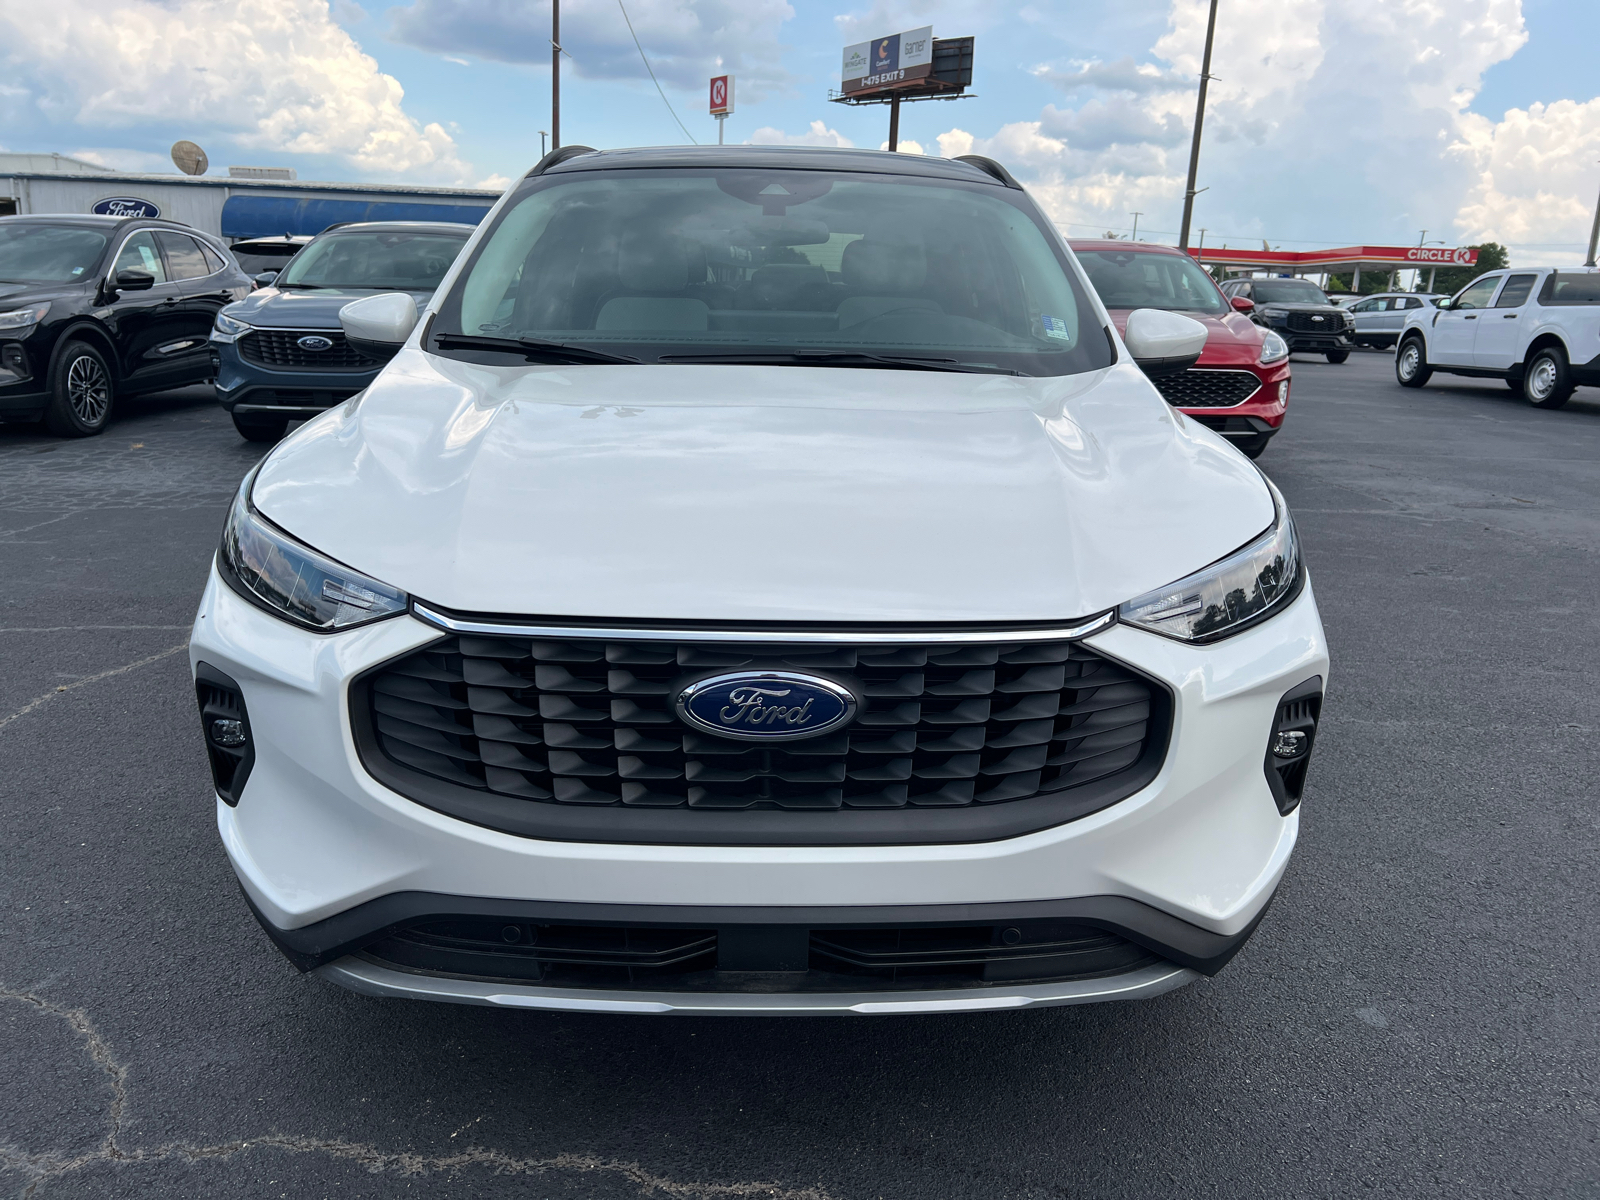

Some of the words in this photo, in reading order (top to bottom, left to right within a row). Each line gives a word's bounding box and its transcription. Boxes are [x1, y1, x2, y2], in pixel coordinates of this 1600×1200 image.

[861, 75, 880, 87] I-475
[881, 70, 899, 83] EXIT
[899, 70, 905, 79] 9
[715, 83, 725, 103] K
[106, 200, 146, 217] Ford
[1407, 249, 1452, 261] CIRCLE
[1456, 250, 1469, 263] K
[719, 686, 815, 725] Ford
